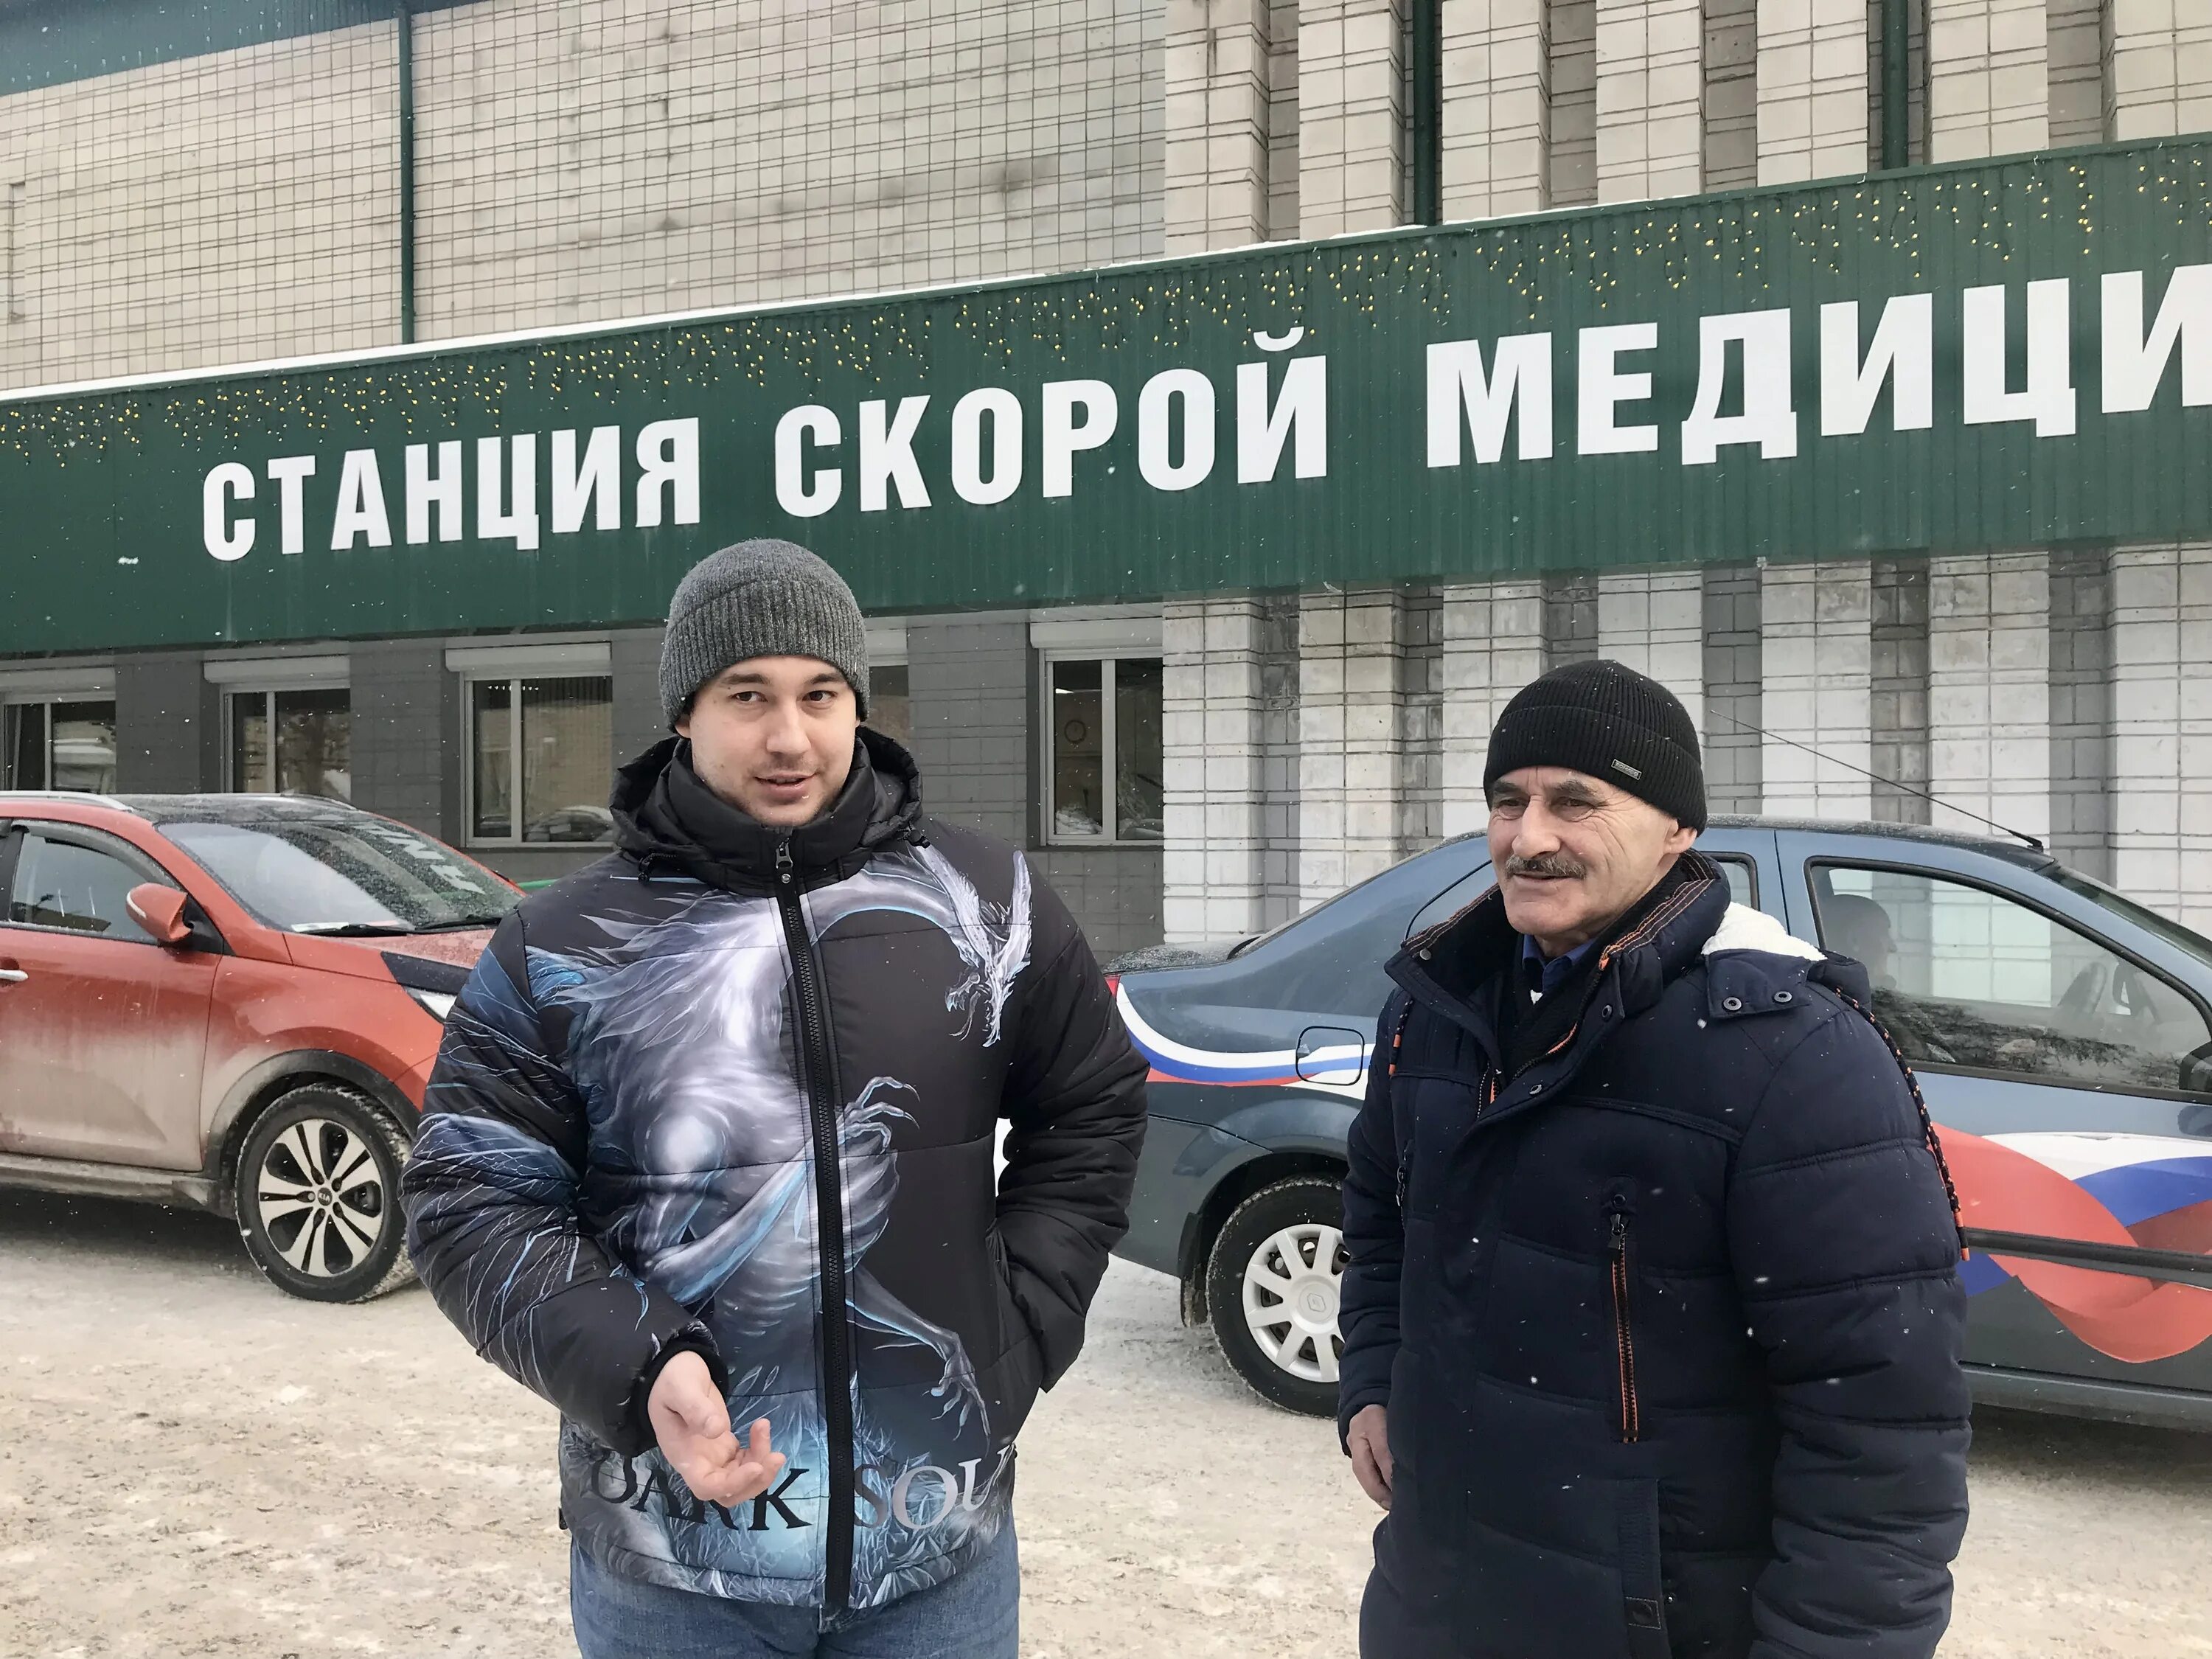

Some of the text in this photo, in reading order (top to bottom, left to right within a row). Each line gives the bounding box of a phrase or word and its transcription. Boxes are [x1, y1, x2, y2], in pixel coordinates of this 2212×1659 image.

[204, 263, 2212, 561] СТАНЦИЯ СКОРОЙ МЕДИЦИ
